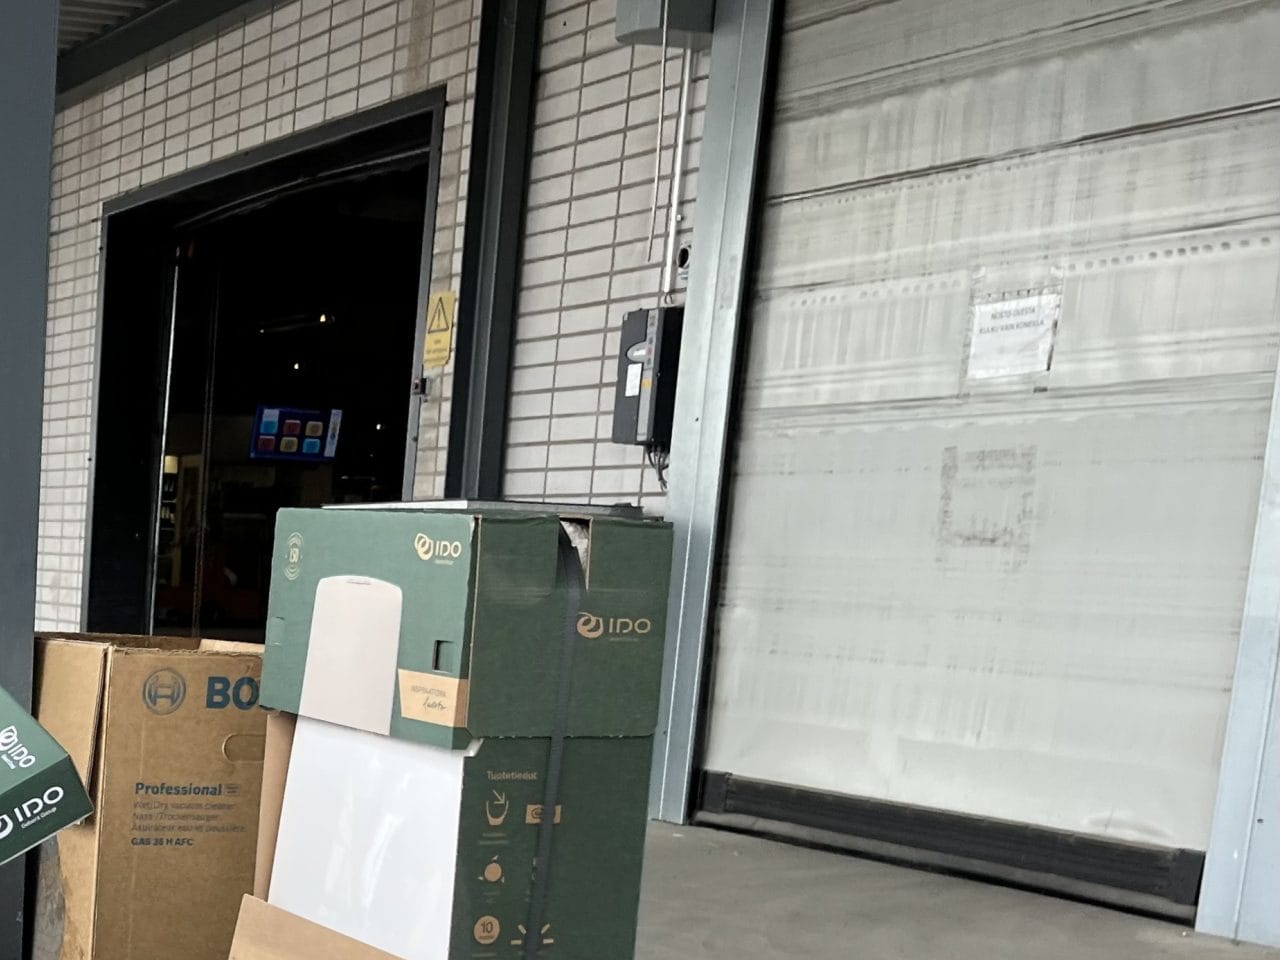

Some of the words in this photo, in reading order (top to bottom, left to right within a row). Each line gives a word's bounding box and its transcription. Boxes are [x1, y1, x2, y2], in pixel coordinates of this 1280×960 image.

[435, 540, 462, 558] IDO
[608, 617, 652, 634] IDO
[206, 676, 260, 711] BO
[7, 743, 36, 768] IDO
[135, 782, 223, 796] Professional
[14, 786, 64, 822] IDO
[480, 921, 494, 934] 10
